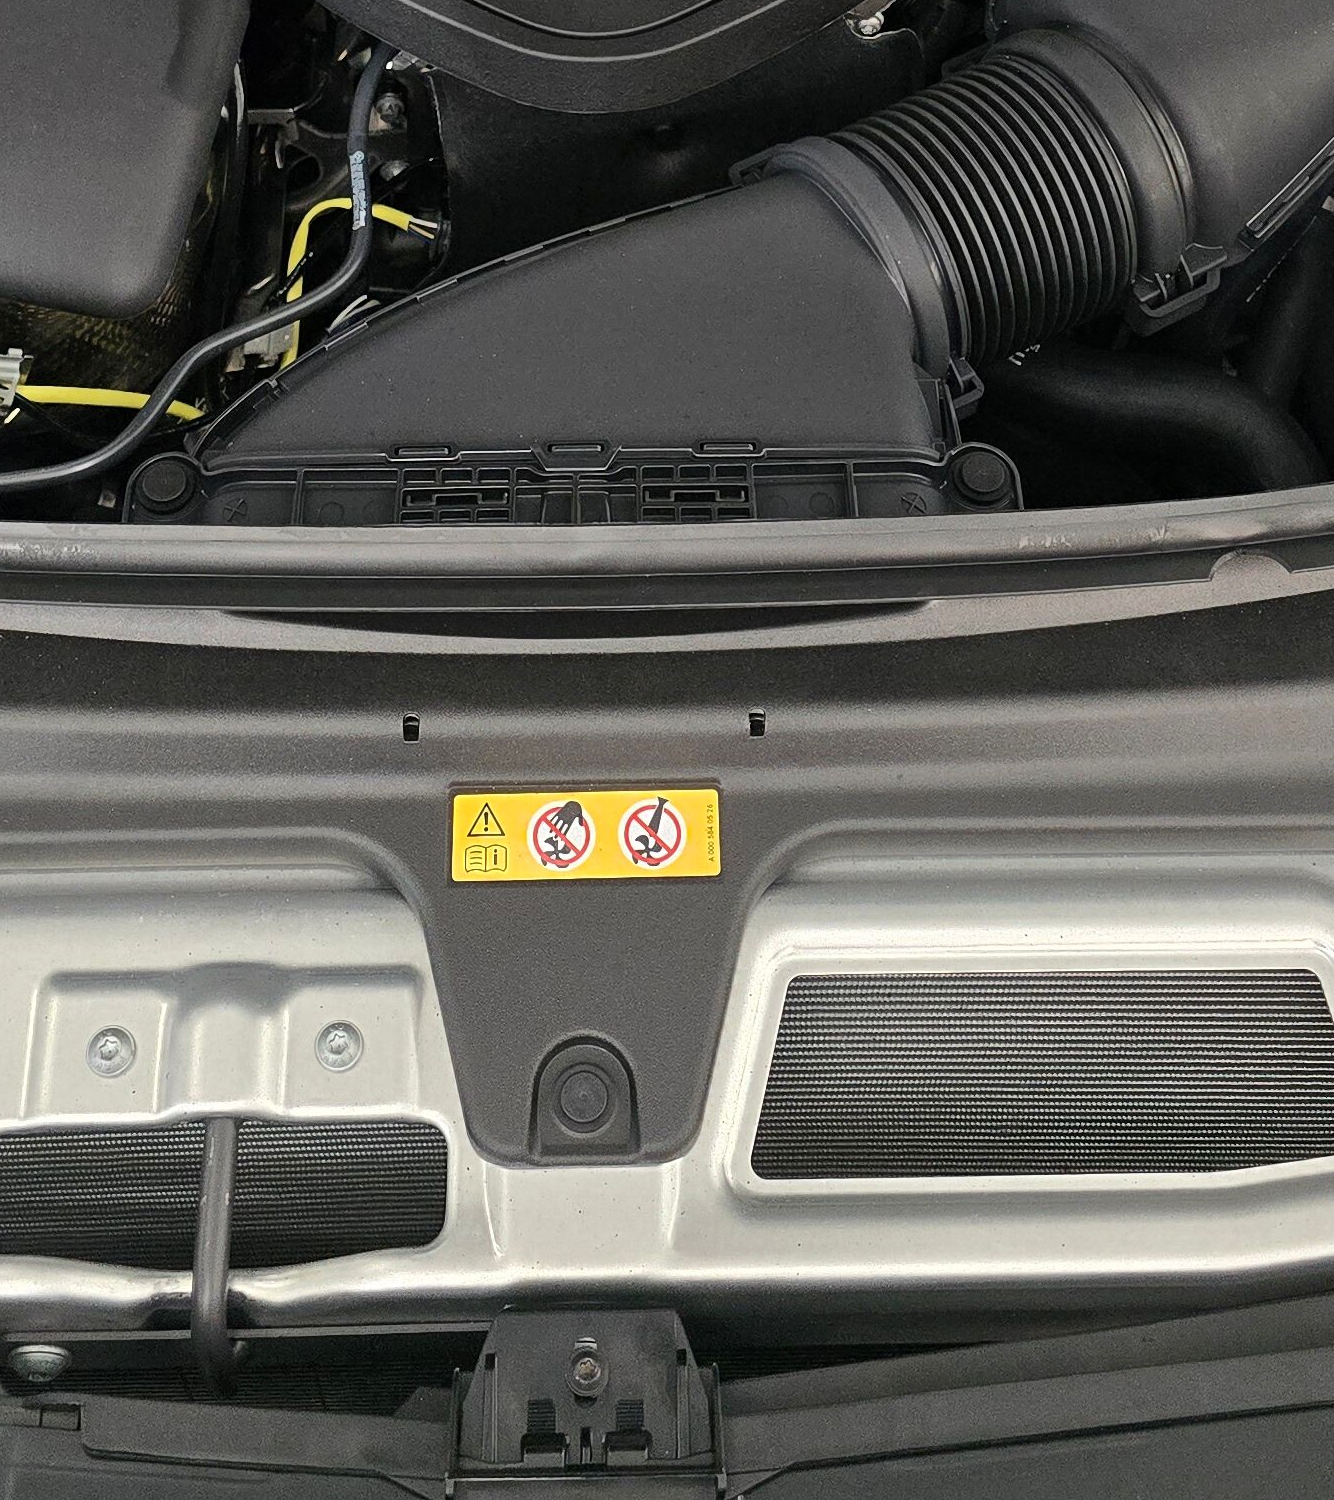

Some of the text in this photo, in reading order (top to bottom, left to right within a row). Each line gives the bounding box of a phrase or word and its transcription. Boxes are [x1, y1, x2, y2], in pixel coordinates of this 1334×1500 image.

[707, 803, 714, 812] 26
[707, 814, 714, 823] 05
[707, 825, 715, 839] 584
[707, 841, 715, 855] 000
